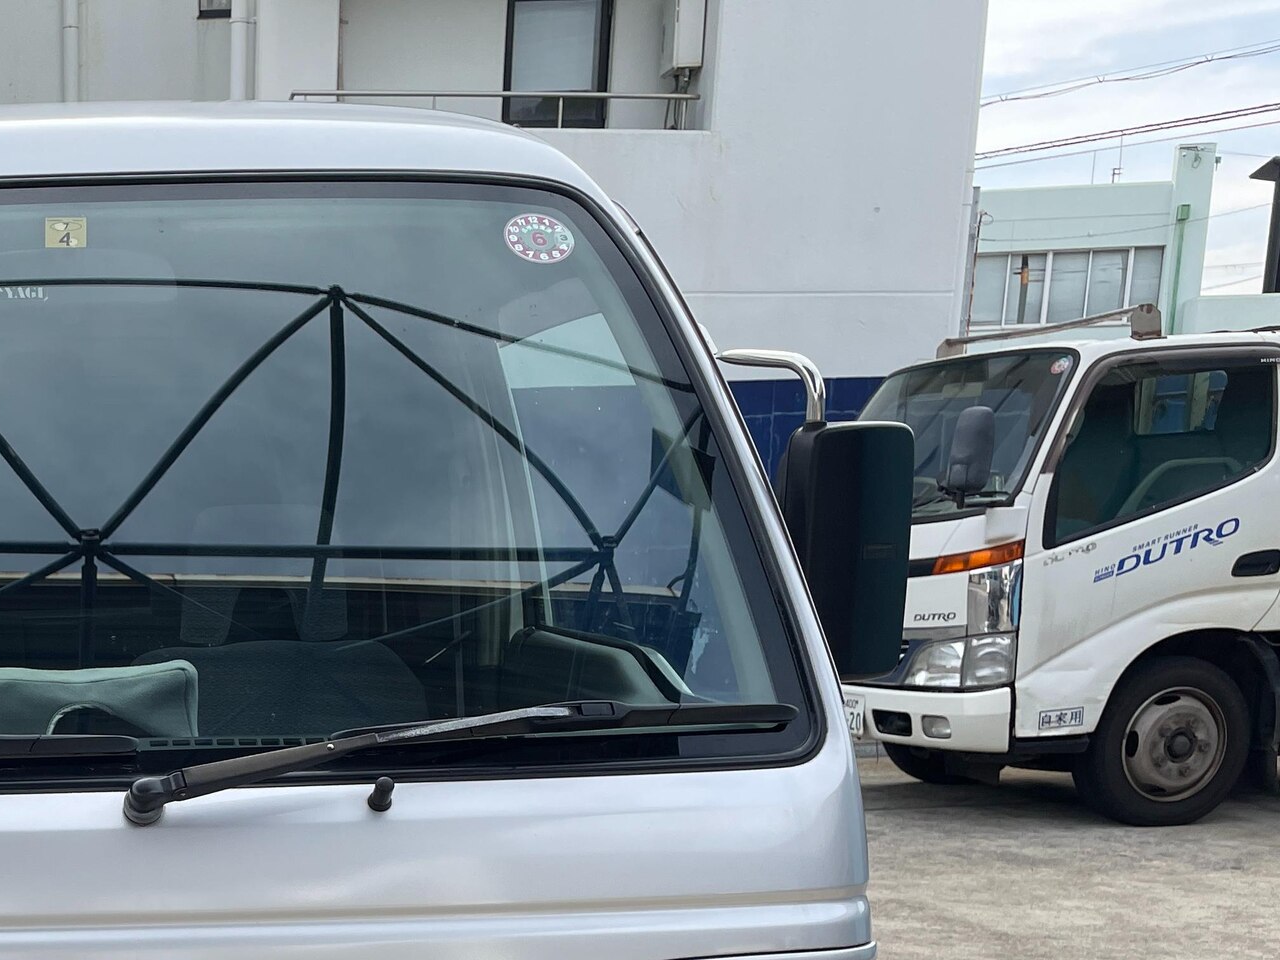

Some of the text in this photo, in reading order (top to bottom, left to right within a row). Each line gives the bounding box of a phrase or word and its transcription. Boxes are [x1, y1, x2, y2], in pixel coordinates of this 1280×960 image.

[527, 216, 538, 224] 12
[509, 225, 520, 233] 10
[59, 231, 72, 247] 4
[531, 231, 548, 247] 6
[525, 250, 535, 258] 7
[539, 252, 549, 260] 6
[551, 250, 561, 258] 5
[1132, 523, 1199, 553] SMART RUNNER
[1115, 517, 1240, 577] DUTRO
[913, 612, 957, 622] DUTRO
[1041, 710, 1082, 727] 自家用
